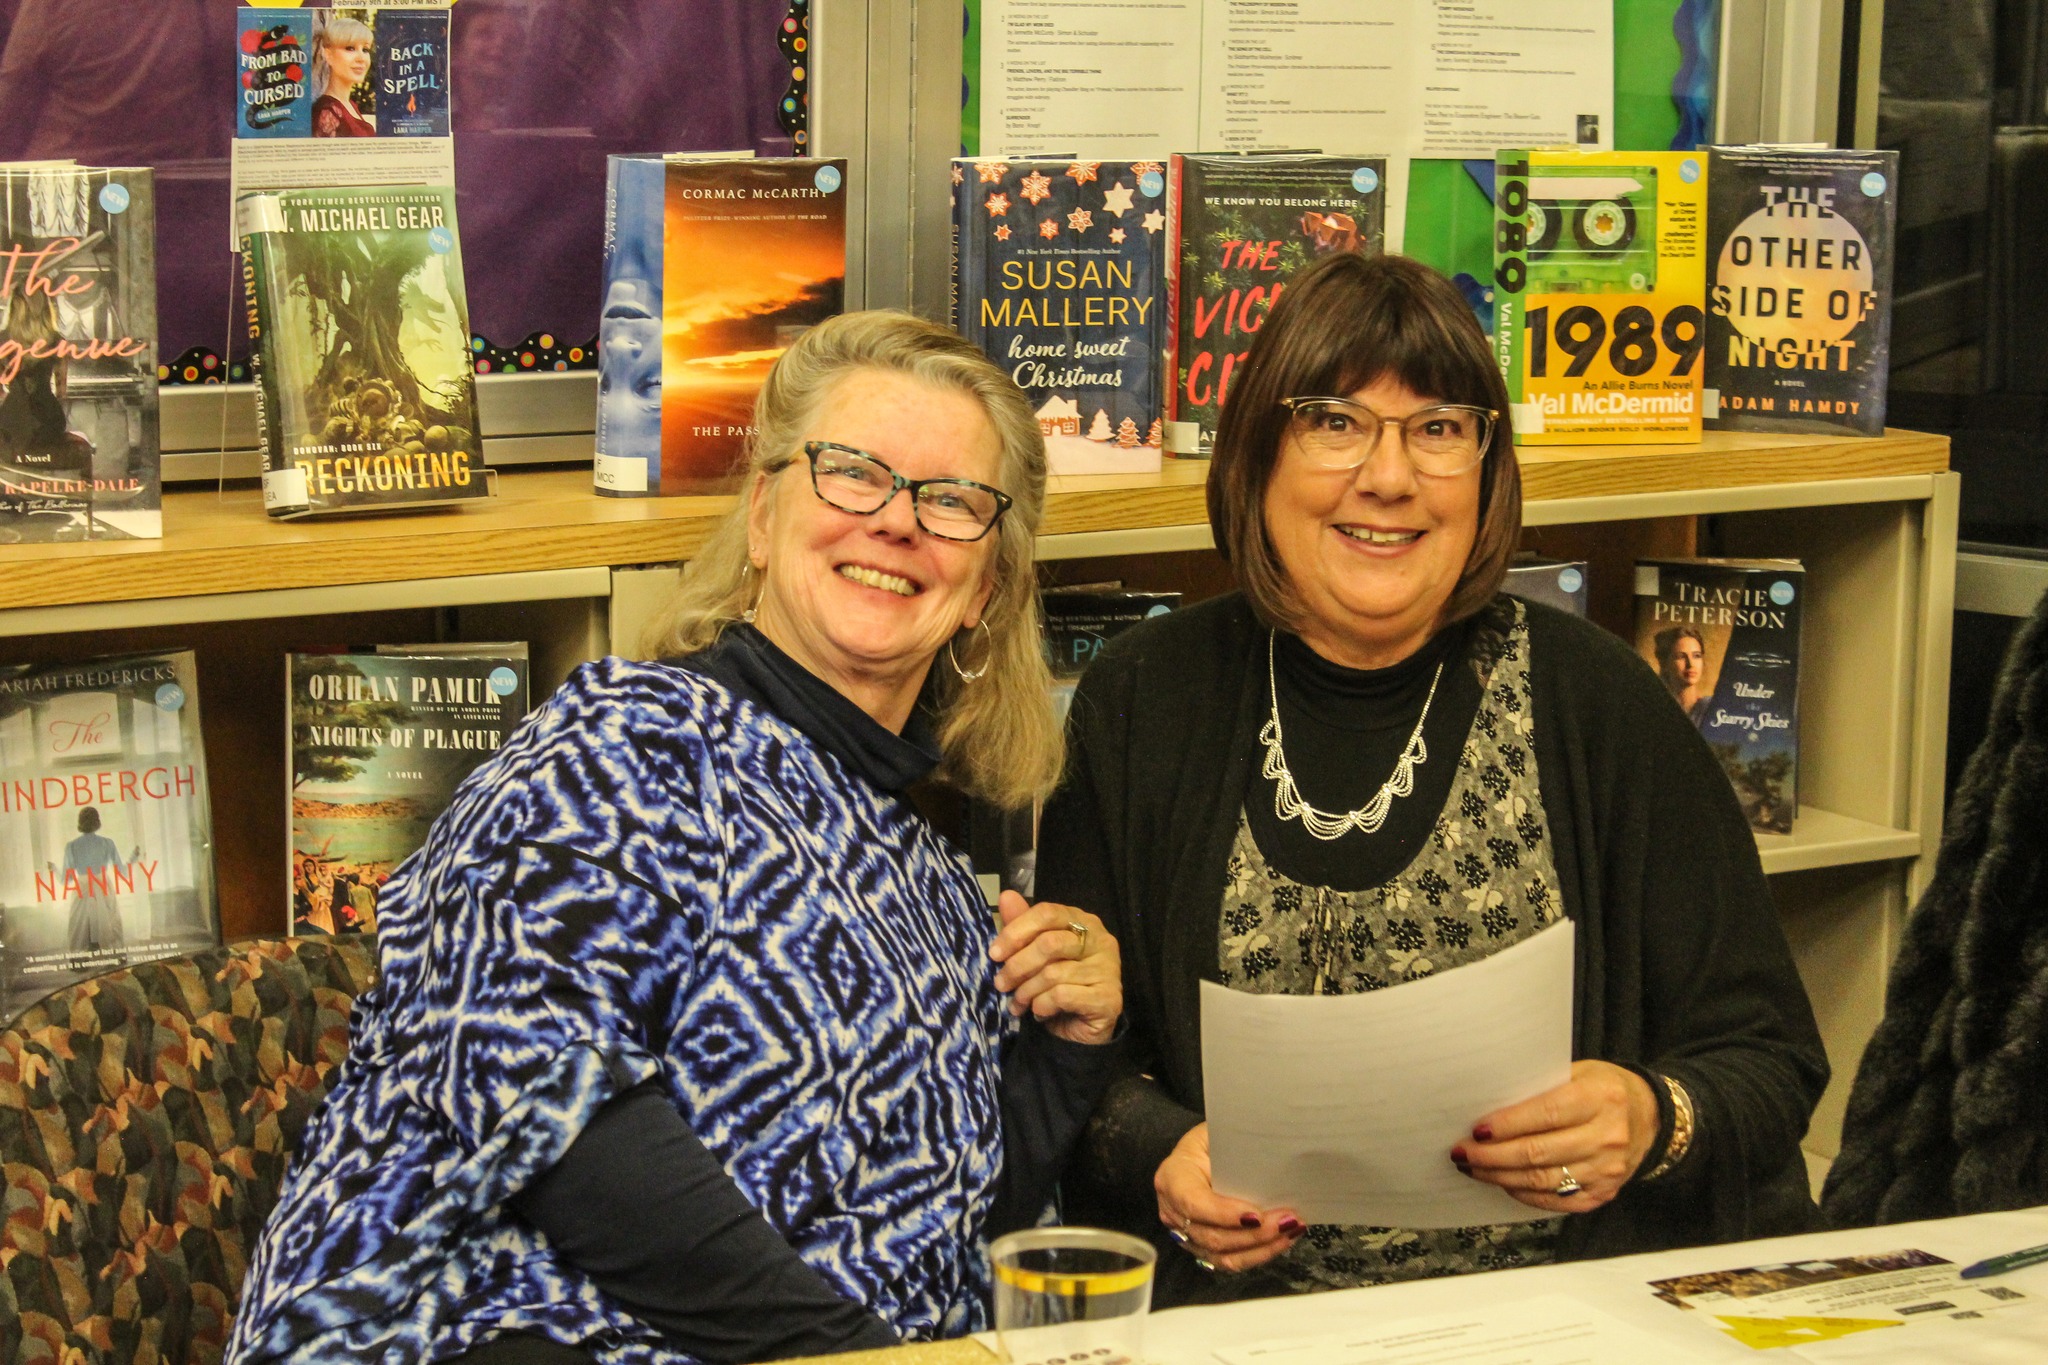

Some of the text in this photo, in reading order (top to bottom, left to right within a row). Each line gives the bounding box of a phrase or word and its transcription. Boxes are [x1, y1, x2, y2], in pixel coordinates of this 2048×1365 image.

[241, 50, 308, 69] FROM BAD
[390, 43, 434, 61] BACK
[267, 71, 281, 82] TO
[399, 60, 425, 76] IN A
[244, 86, 305, 105] CURSED
[384, 74, 441, 94] SPELL
[818, 171, 838, 187] NEW
[1141, 179, 1162, 192] NEW
[1353, 175, 1375, 186] NEW
[291, 198, 314, 206] YORK
[317, 197, 345, 206] TIMES
[348, 196, 406, 205] BESTSELLING
[409, 195, 442, 203] AUTHOR
[682, 188, 747, 199] CORMAC
[1204, 197, 1358, 208] WE KNOW YOU BELONG HERE
[1760, 185, 1836, 218] THE
[301, 207, 391, 232] MICHAEL
[396, 206, 445, 230] GEAR
[431, 231, 451, 248] NEW
[1220, 240, 1283, 271] THE
[1731, 235, 1861, 271] OTHER
[951, 224, 960, 333] SUSAN MALLE
[1000, 260, 1132, 291] SUSAN
[239, 236, 261, 340] CKONING
[980, 296, 1154, 328] MALLERY
[1711, 284, 1878, 322] SIDE OF
[1007, 334, 1131, 359] home sweet
[1500, 303, 1512, 383] Val McDe
[1524, 304, 1706, 378] 1989
[0, 332, 149, 385] genue
[251, 353, 262, 371] W.
[1728, 334, 1856, 372] NIGHT
[1012, 360, 1123, 389] Christmas
[1582, 380, 1693, 391] An Allie Burns Novel
[253, 373, 268, 434] MICHAEL
[1528, 392, 1694, 415] Val McDermid
[1719, 396, 1861, 415] ADAM HAMDY
[692, 426, 722, 437] THE
[1544, 417, 1602, 425] ERNATIONALLY
[15, 453, 52, 464] A Novel
[260, 437, 271, 473] GEAR
[293, 443, 383, 456] DONOVAN: BOOK SIX
[294, 450, 471, 496] RECKONING
[1675, 581, 1768, 608] TRACIE
[1654, 602, 1786, 629] PETERSON
[0, 665, 177, 694] ARIAH FREDERICKS
[308, 674, 502, 705] ORHAN PAMUK
[491, 677, 515, 687] NEW
[1732, 681, 1775, 699] Under
[158, 688, 182, 709] NEW
[50, 712, 111, 753] The
[310, 725, 501, 750] NIGHTS OF PLAGUE
[396, 771, 424, 780] NOVEL
[0, 765, 196, 813] INDBERGH
[35, 860, 158, 903] NANNY
[149, 943, 162, 951] that
[23, 964, 58, 974] compelling
